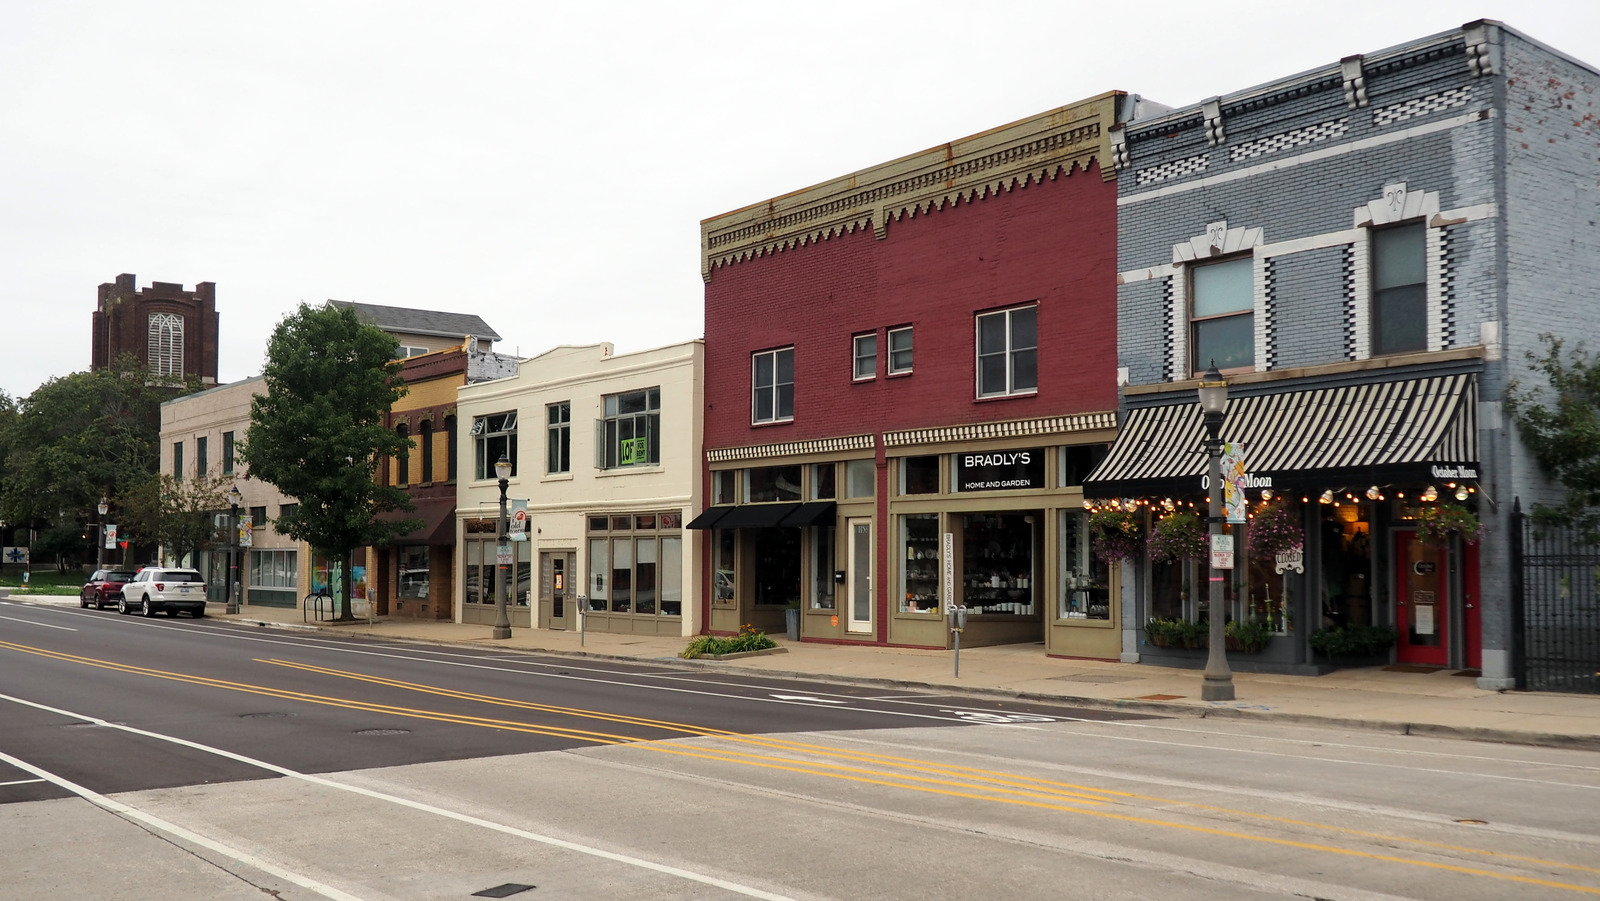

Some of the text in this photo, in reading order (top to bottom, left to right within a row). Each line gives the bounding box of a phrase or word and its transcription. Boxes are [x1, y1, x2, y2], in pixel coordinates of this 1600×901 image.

[622, 441, 636, 462] LOF
[965, 452, 1031, 467] BRADLY'S
[1432, 464, 1478, 479] October Moon
[965, 481, 985, 489] HOME
[1001, 479, 1031, 487] GARDEN
[1244, 472, 1272, 489] Moon
